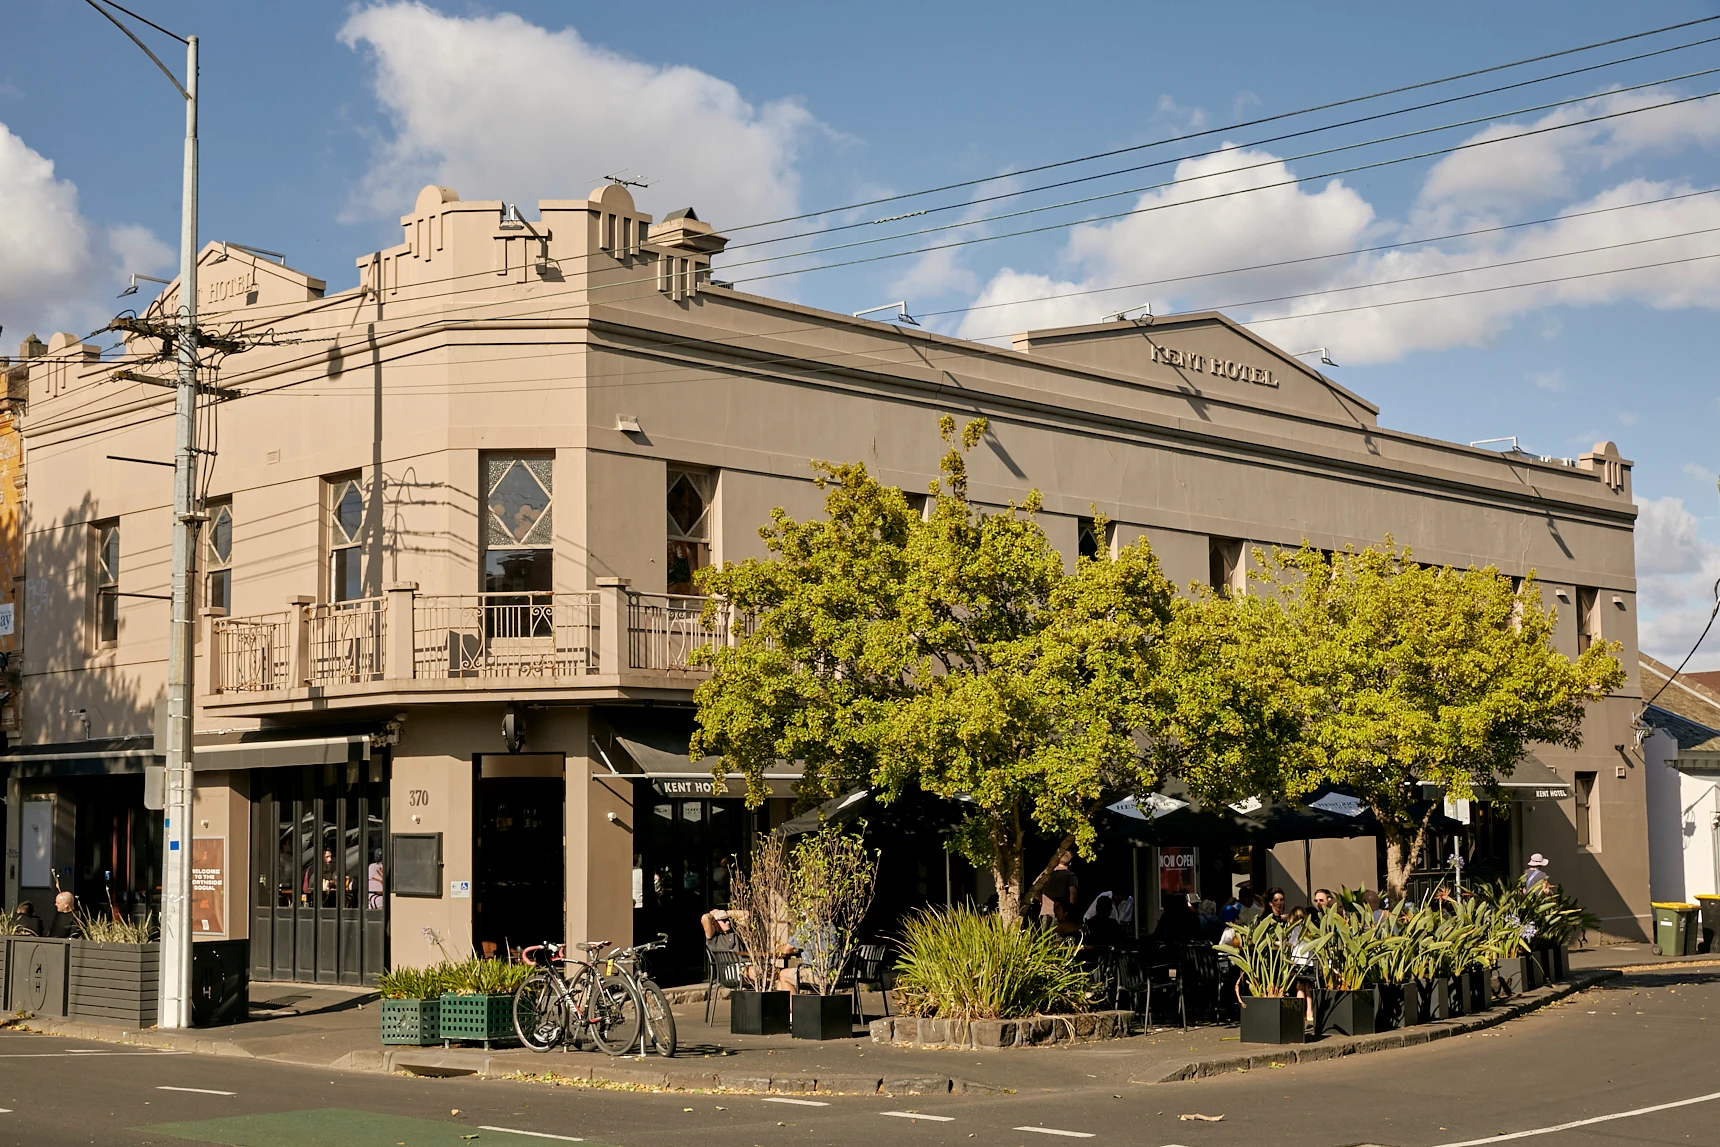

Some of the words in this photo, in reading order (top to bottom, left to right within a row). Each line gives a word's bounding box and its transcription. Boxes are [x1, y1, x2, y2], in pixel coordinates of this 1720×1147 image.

[208, 273, 253, 304] HOTEL
[1151, 344, 1204, 373] KENT
[1209, 356, 1279, 389] HOTEL
[664, 782, 692, 793] KENT
[1535, 790, 1549, 798] KENT
[409, 789, 429, 806] 370
[1176, 854, 1194, 867] OPEN
